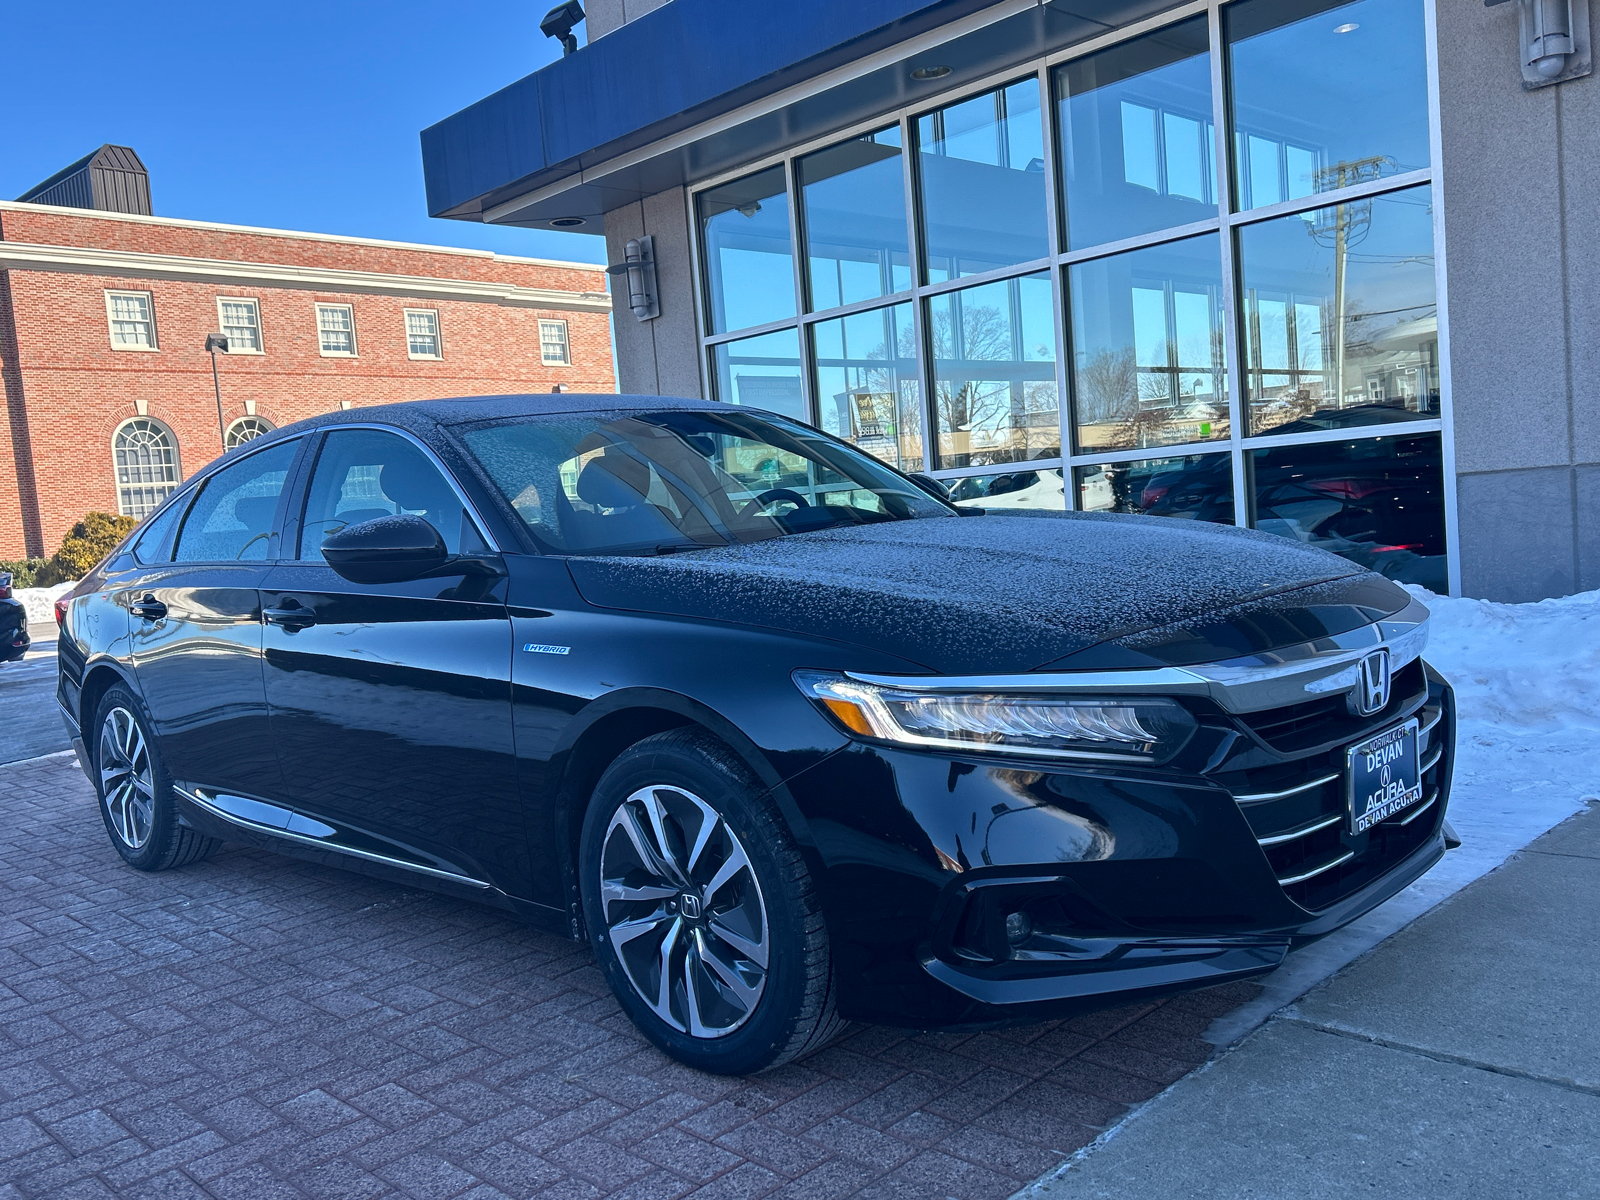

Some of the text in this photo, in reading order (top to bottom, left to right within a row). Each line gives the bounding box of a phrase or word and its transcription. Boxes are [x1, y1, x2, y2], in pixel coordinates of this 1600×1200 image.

[529, 644, 567, 653] HYBRID
[1366, 739, 1403, 773] DEVAN
[1366, 778, 1405, 813] ACURA
